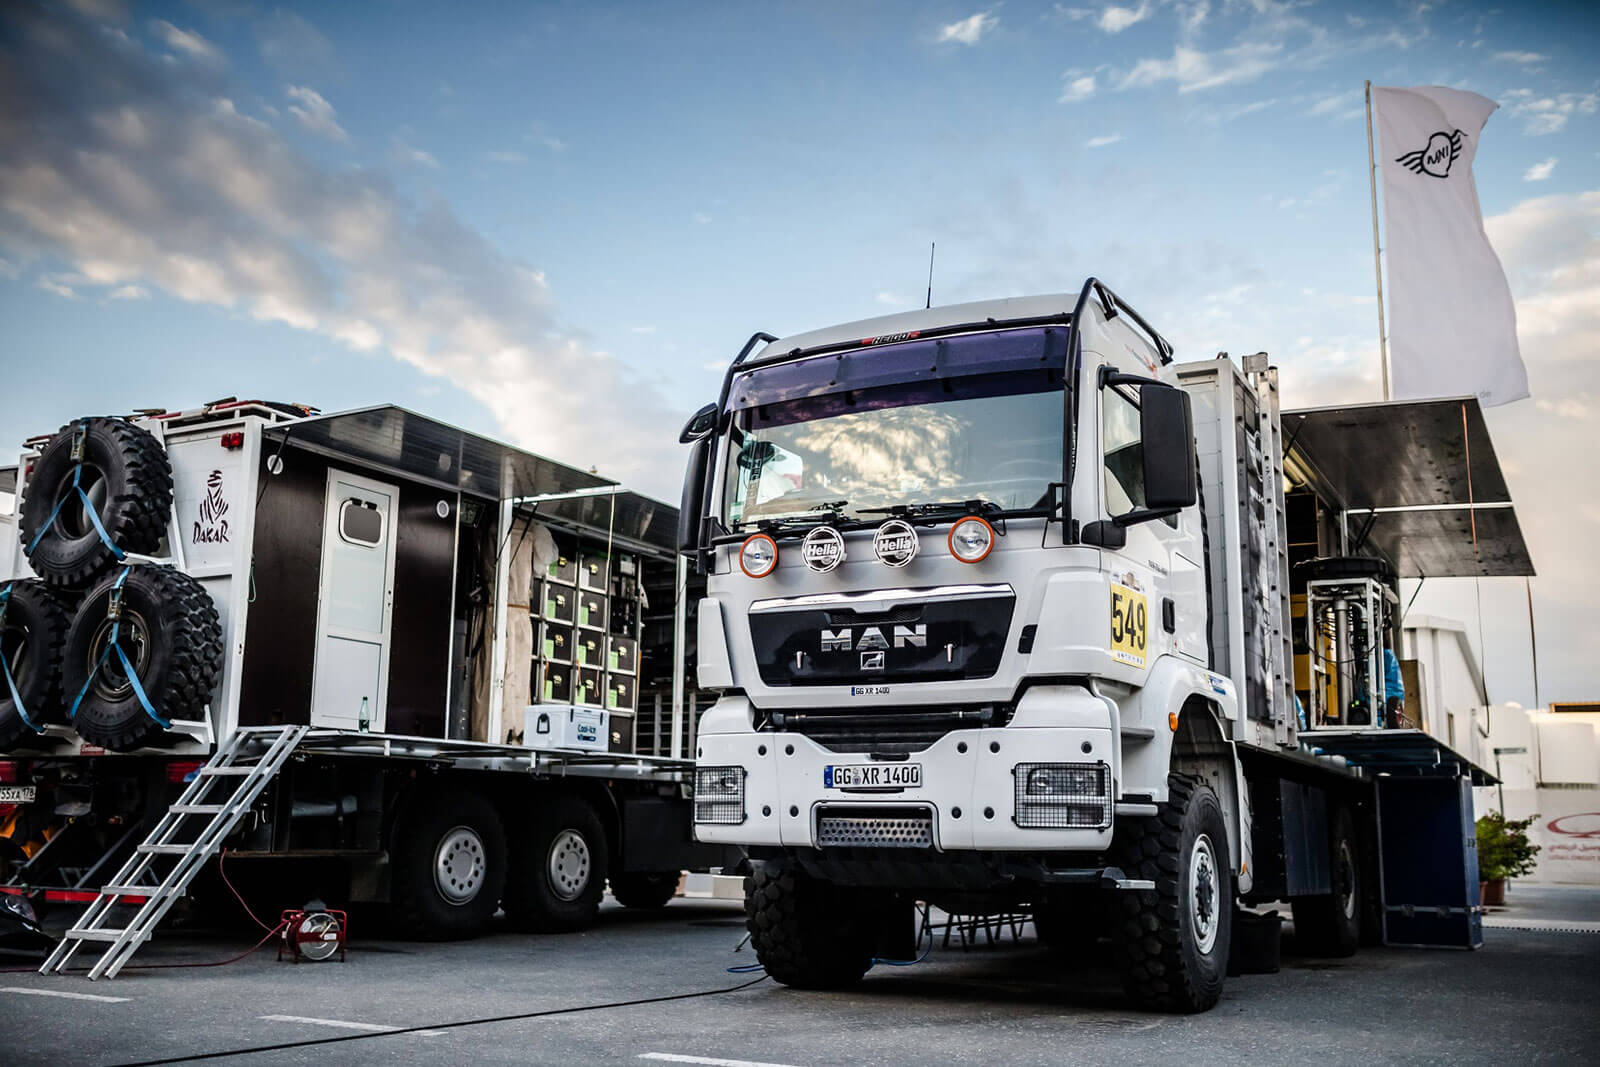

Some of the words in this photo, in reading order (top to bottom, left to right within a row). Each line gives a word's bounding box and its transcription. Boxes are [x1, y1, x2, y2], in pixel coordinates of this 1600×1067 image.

[193, 519, 229, 544] DAKAR
[806, 543, 838, 556] Hella
[878, 537, 912, 551] Hella
[1112, 592, 1146, 650] 549
[821, 624, 927, 651] MAN
[834, 768, 851, 785] GG
[862, 767, 879, 785] XR
[883, 766, 919, 784] 1400
